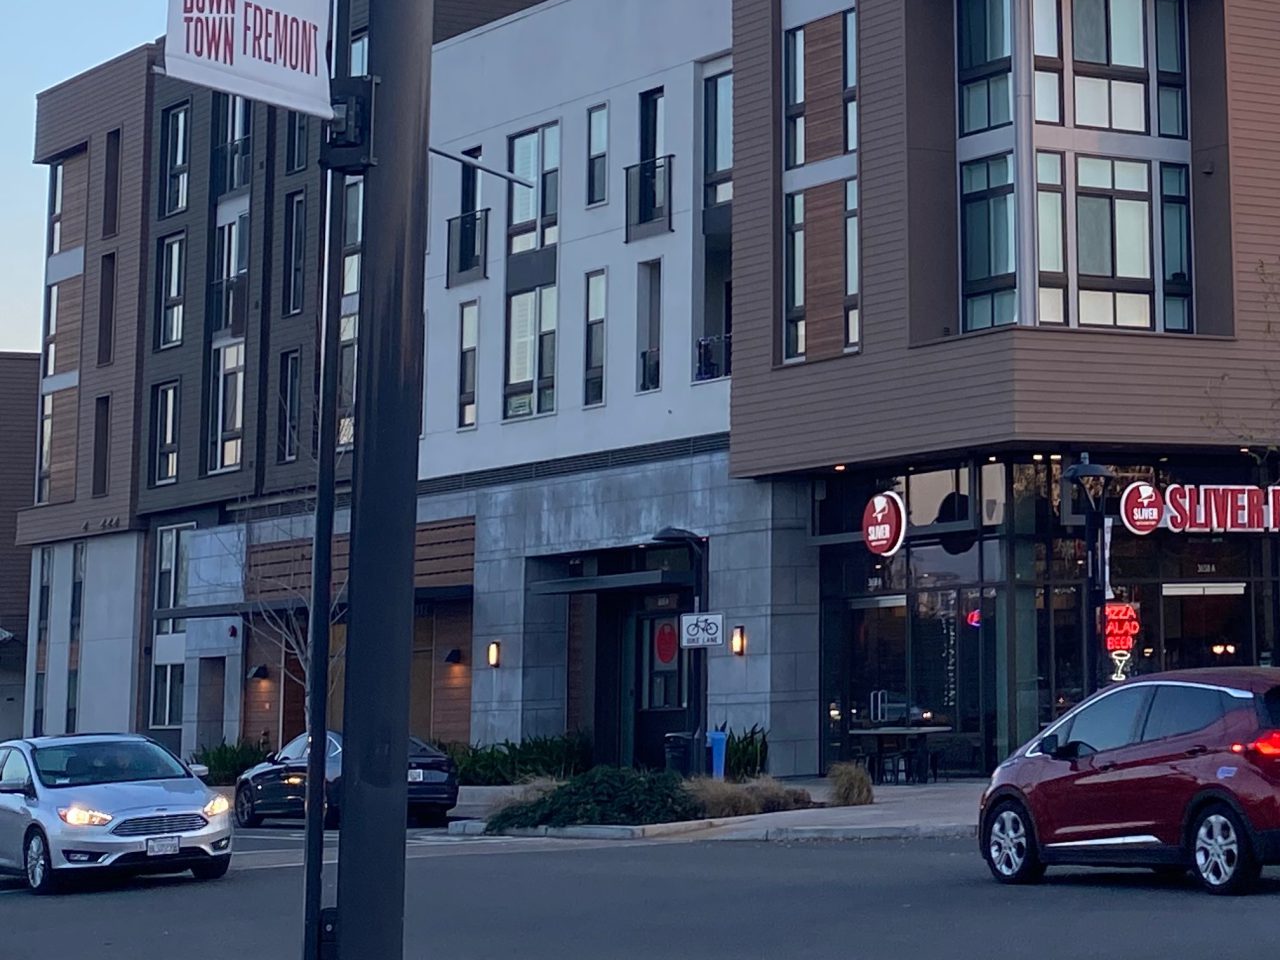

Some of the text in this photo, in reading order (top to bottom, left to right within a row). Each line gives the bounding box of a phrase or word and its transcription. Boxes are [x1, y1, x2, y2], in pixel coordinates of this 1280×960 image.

[183, 16, 235, 66] TOWN
[243, 1, 319, 77] FREMONT
[1133, 507, 1159, 520] SLIVER
[1166, 485, 1265, 532] SLIVER
[1105, 621, 1140, 635] ALAD
[702, 636, 718, 644] LANE
[1107, 635, 1133, 650] BEER
